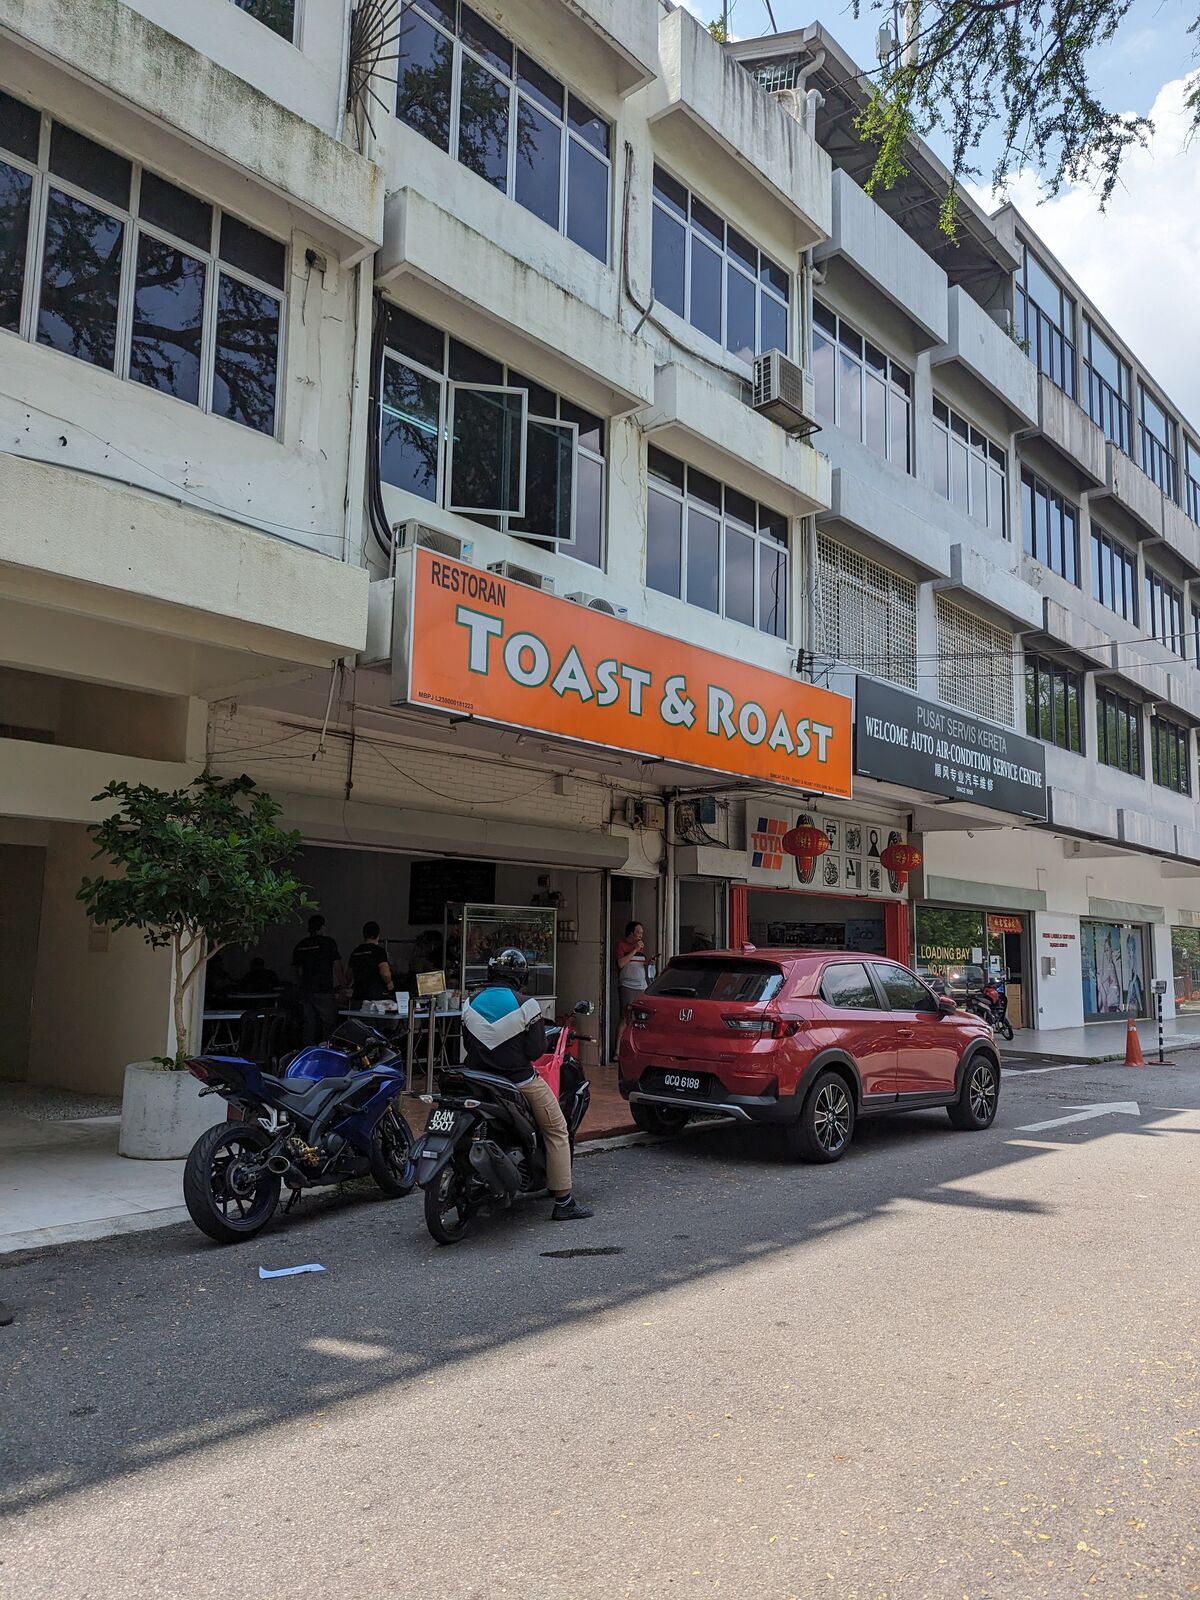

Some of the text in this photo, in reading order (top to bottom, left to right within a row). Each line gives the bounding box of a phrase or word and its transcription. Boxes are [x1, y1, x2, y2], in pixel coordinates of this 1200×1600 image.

[431, 560, 506, 608] RESTORAN
[455, 604, 833, 763] TOAST & ROAST
[418, 691, 434, 701] MBPJ
[916, 705, 1008, 755] PUSAT SERVIS KERETA
[865, 715, 909, 747] WELCOME
[910, 731, 934, 755] AUTO
[992, 756, 1018, 781] SERVICE
[1018, 765, 1042, 789] CENTRE
[751, 833, 786, 854] TOTA
[920, 945, 970, 960] LOADING BAY
[927, 964, 937, 974] NO
[681, 1076, 700, 1090] 6188
[433, 1110, 454, 1121] RAN
[428, 1120, 455, 1132] 3907
